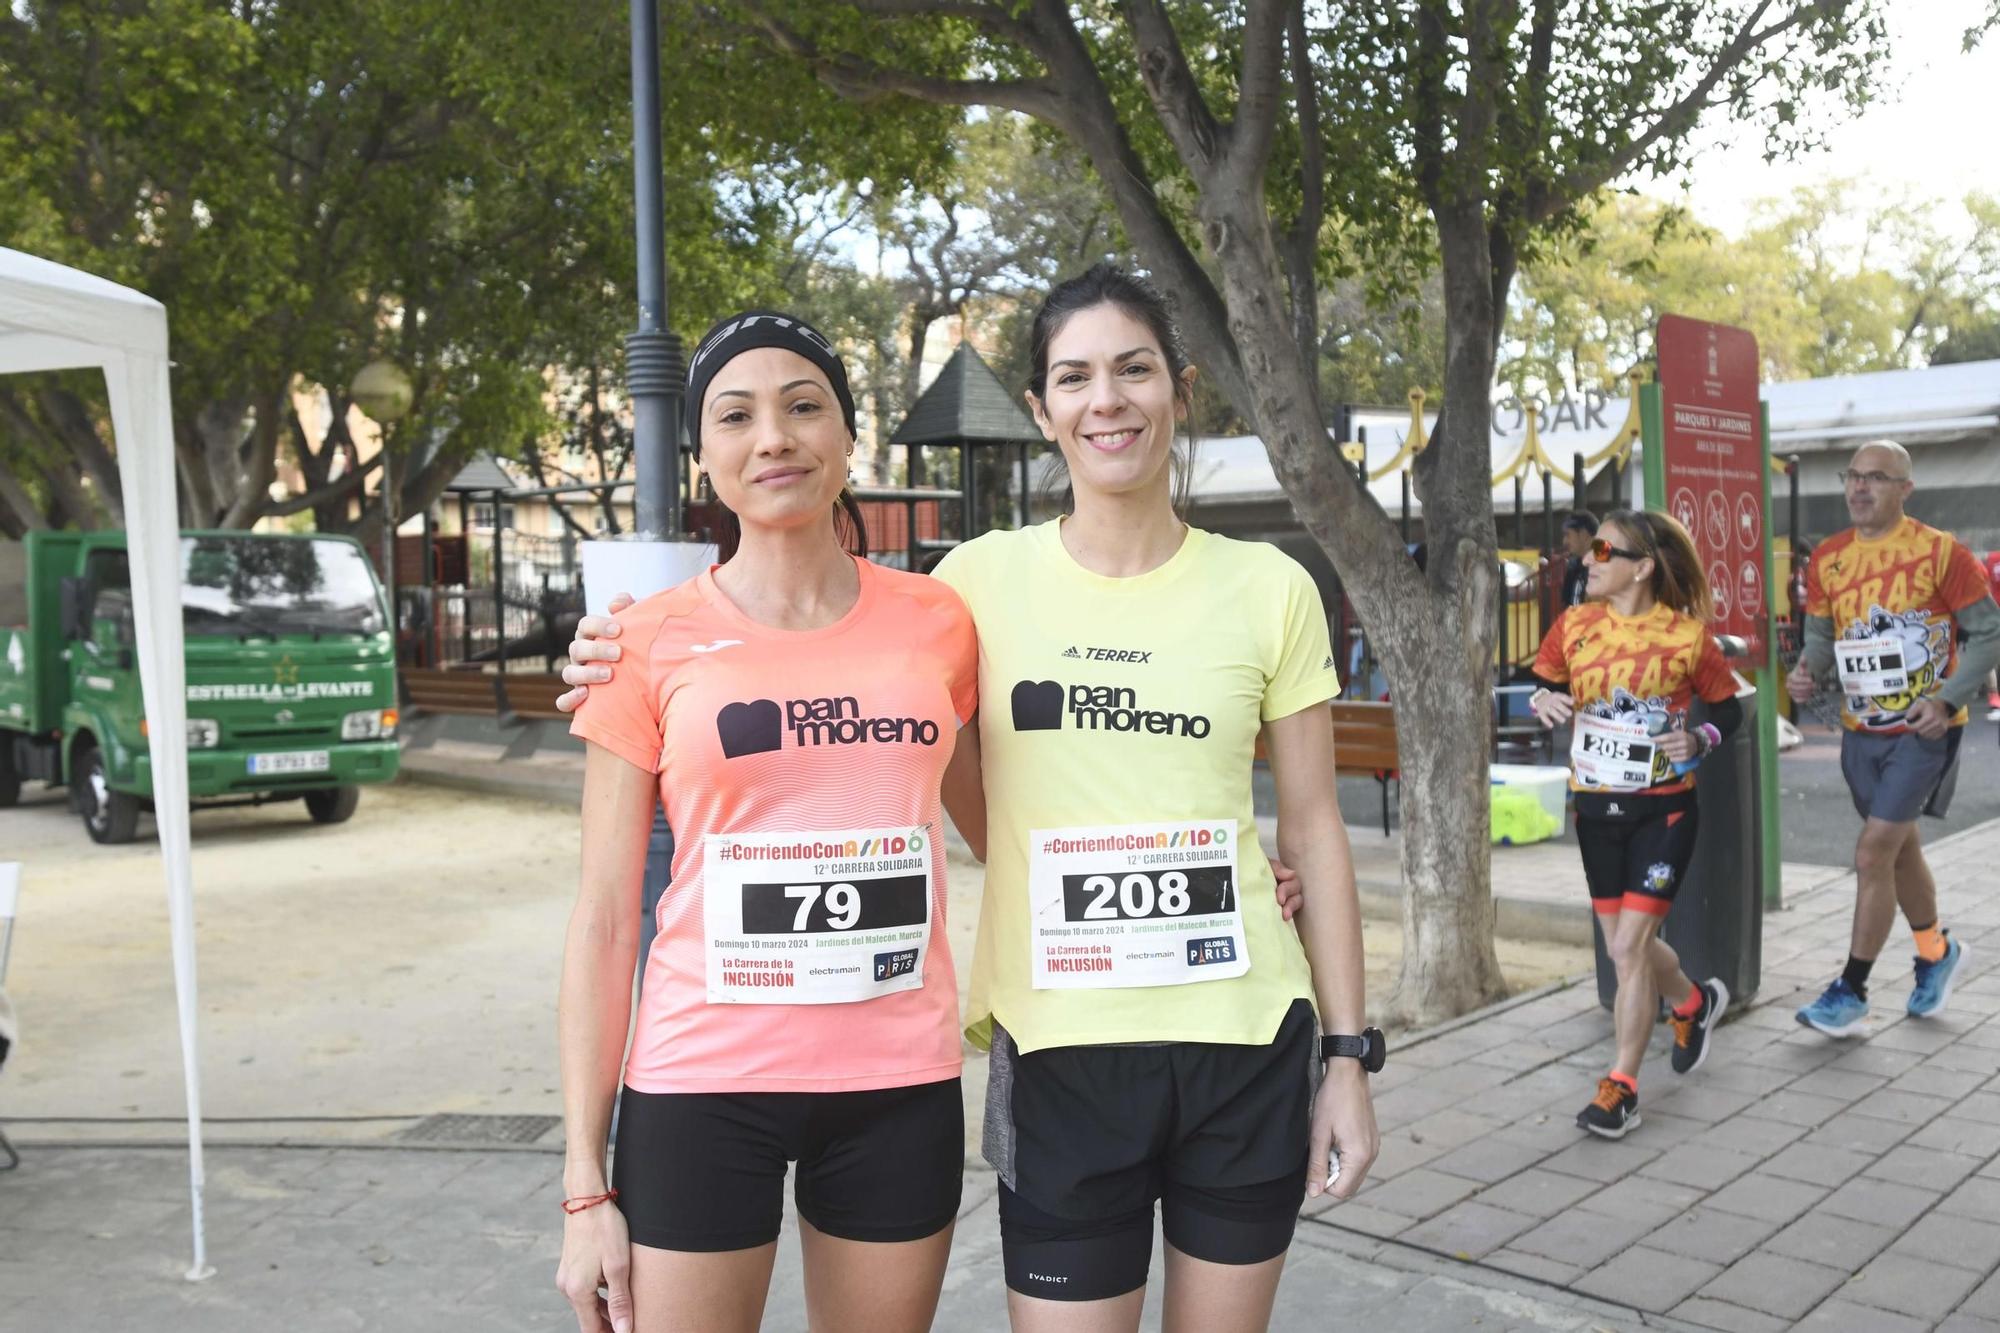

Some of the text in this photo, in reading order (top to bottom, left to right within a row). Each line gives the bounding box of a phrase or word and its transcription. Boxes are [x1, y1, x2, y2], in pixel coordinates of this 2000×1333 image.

[1674, 410, 1752, 434] PARQUES Y JARDINES
[1085, 647, 1153, 664] TERREX
[187, 683, 283, 700] ESTRELLA
[296, 681, 373, 697] LEVANTE
[1069, 684, 1136, 713] pan
[786, 696, 860, 730] pan
[1076, 705, 1211, 739] moreno
[797, 718, 939, 747] moreno
[1588, 735, 1631, 760] 205
[1143, 852, 1185, 865] CARRERA
[1186, 849, 1228, 862] SOLIDARIA
[831, 860, 876, 875] CARRERA
[877, 857, 923, 872] SOLIDARIA
[1082, 871, 1191, 920] 208
[784, 883, 861, 931] 79
[1039, 925, 1125, 937] Domingo 10 marzo 2024
[1131, 924, 1164, 934] Jardines
[1165, 922, 1177, 932] del
[1209, 918, 1233, 928] Murcia
[714, 939, 809, 949] Domingo 10 marzo 2024
[816, 938, 850, 948] Jardines
[852, 935, 864, 945] del
[899, 930, 923, 940] Murcia
[1204, 939, 1230, 948] GLOBAL
[892, 952, 914, 962] GLOBAL
[1046, 944, 1112, 956] La Carrera de la
[722, 958, 794, 969] La Carrera de la
[1047, 956, 1113, 972] INCLUSIÓN
[723, 970, 794, 987] INCLUSIÓN
[1029, 1272, 1068, 1283] EVADICT
